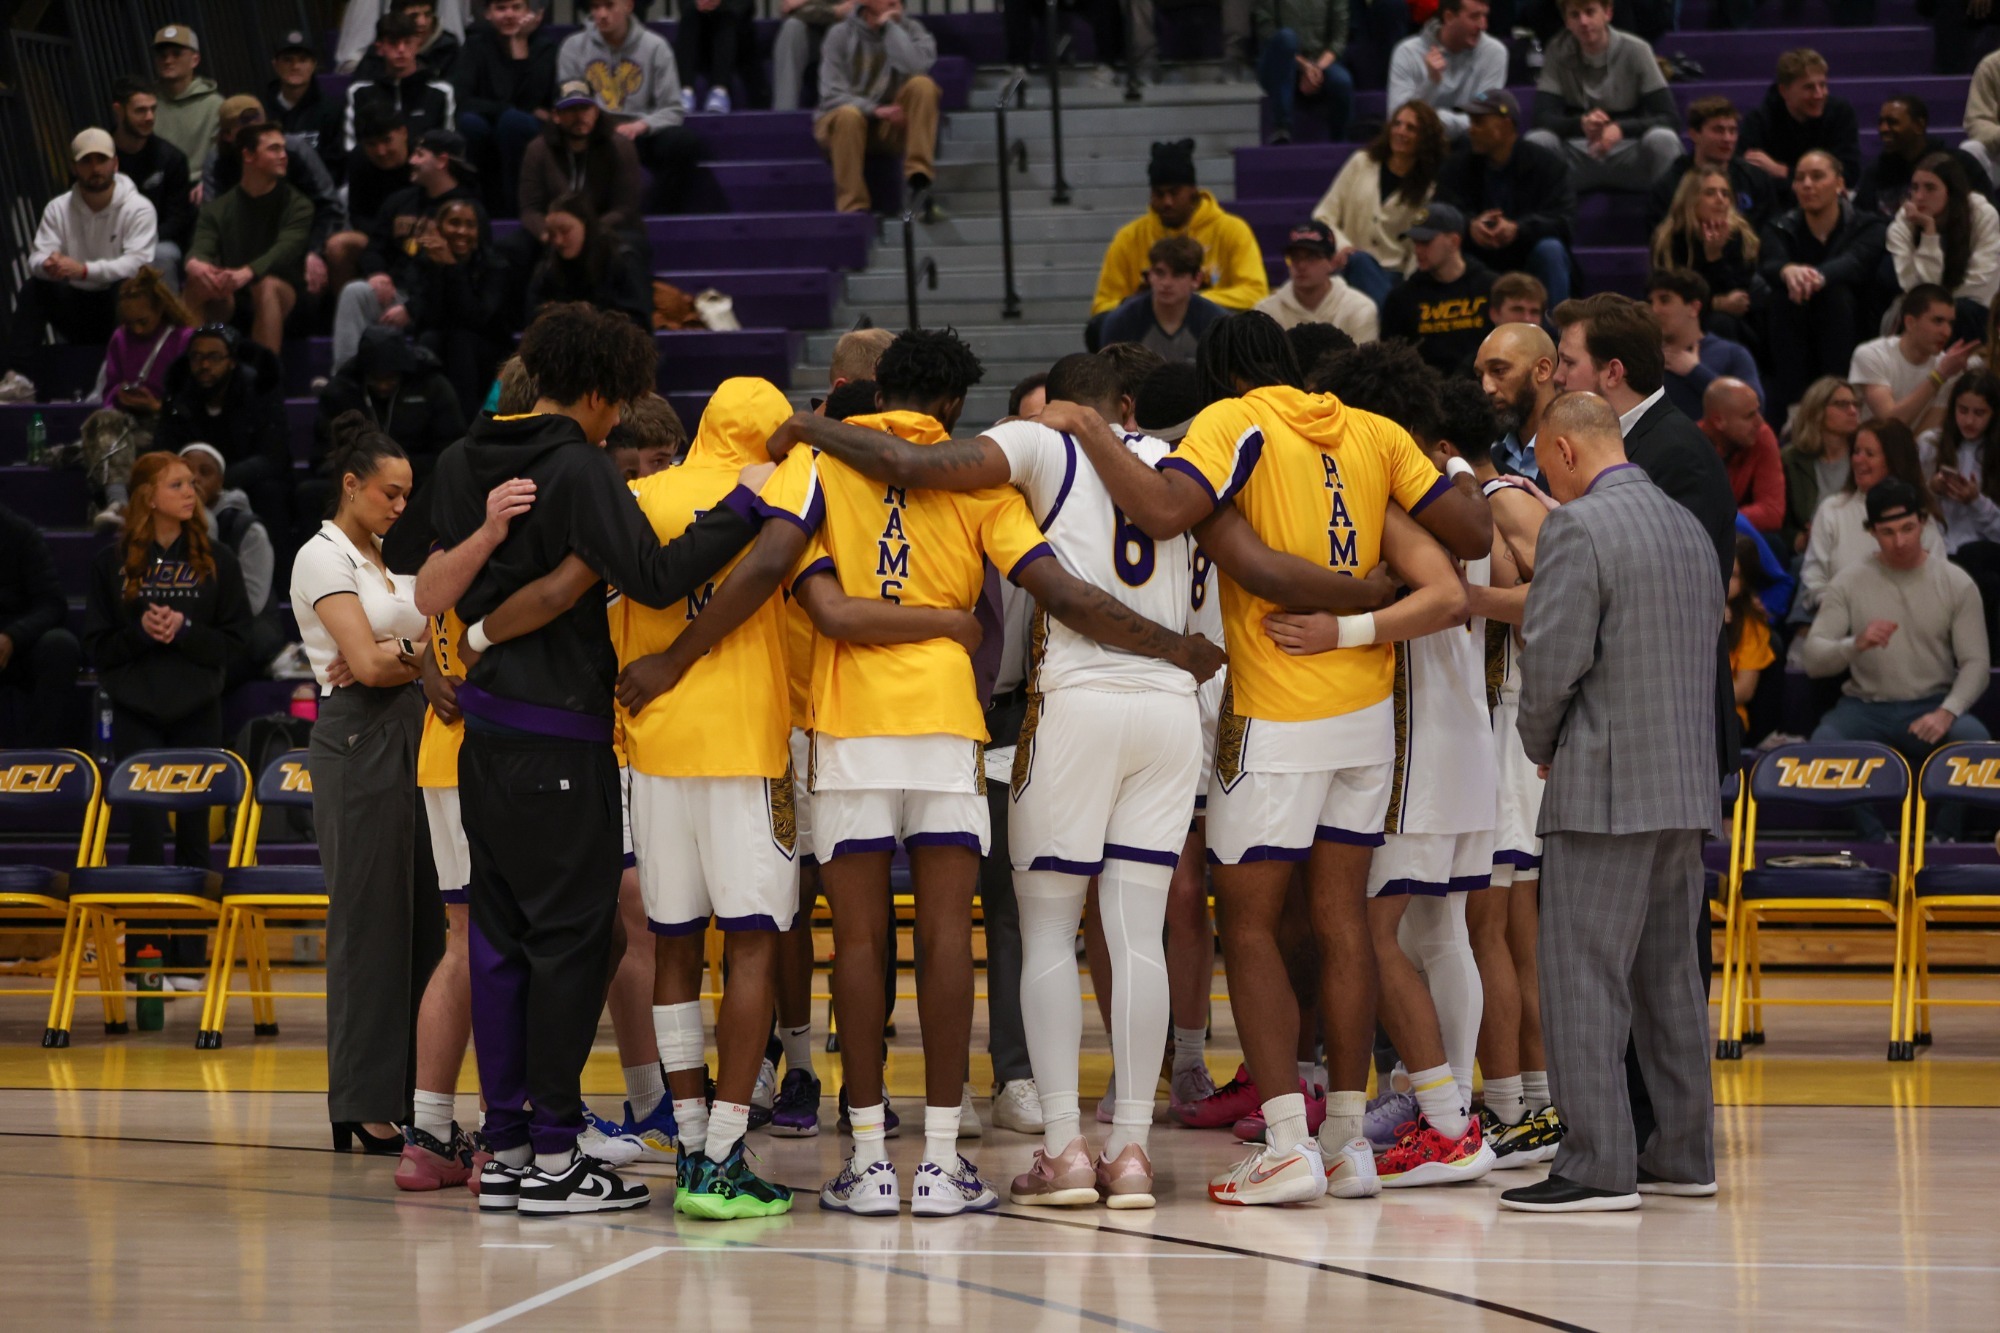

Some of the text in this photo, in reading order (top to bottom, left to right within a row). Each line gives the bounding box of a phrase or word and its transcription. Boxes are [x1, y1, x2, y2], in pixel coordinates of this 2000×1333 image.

[1419, 296, 1487, 320] WCU
[1321, 453, 1359, 577] RAM
[128, 763, 227, 793] WCU
[1776, 757, 1886, 789] WCU
